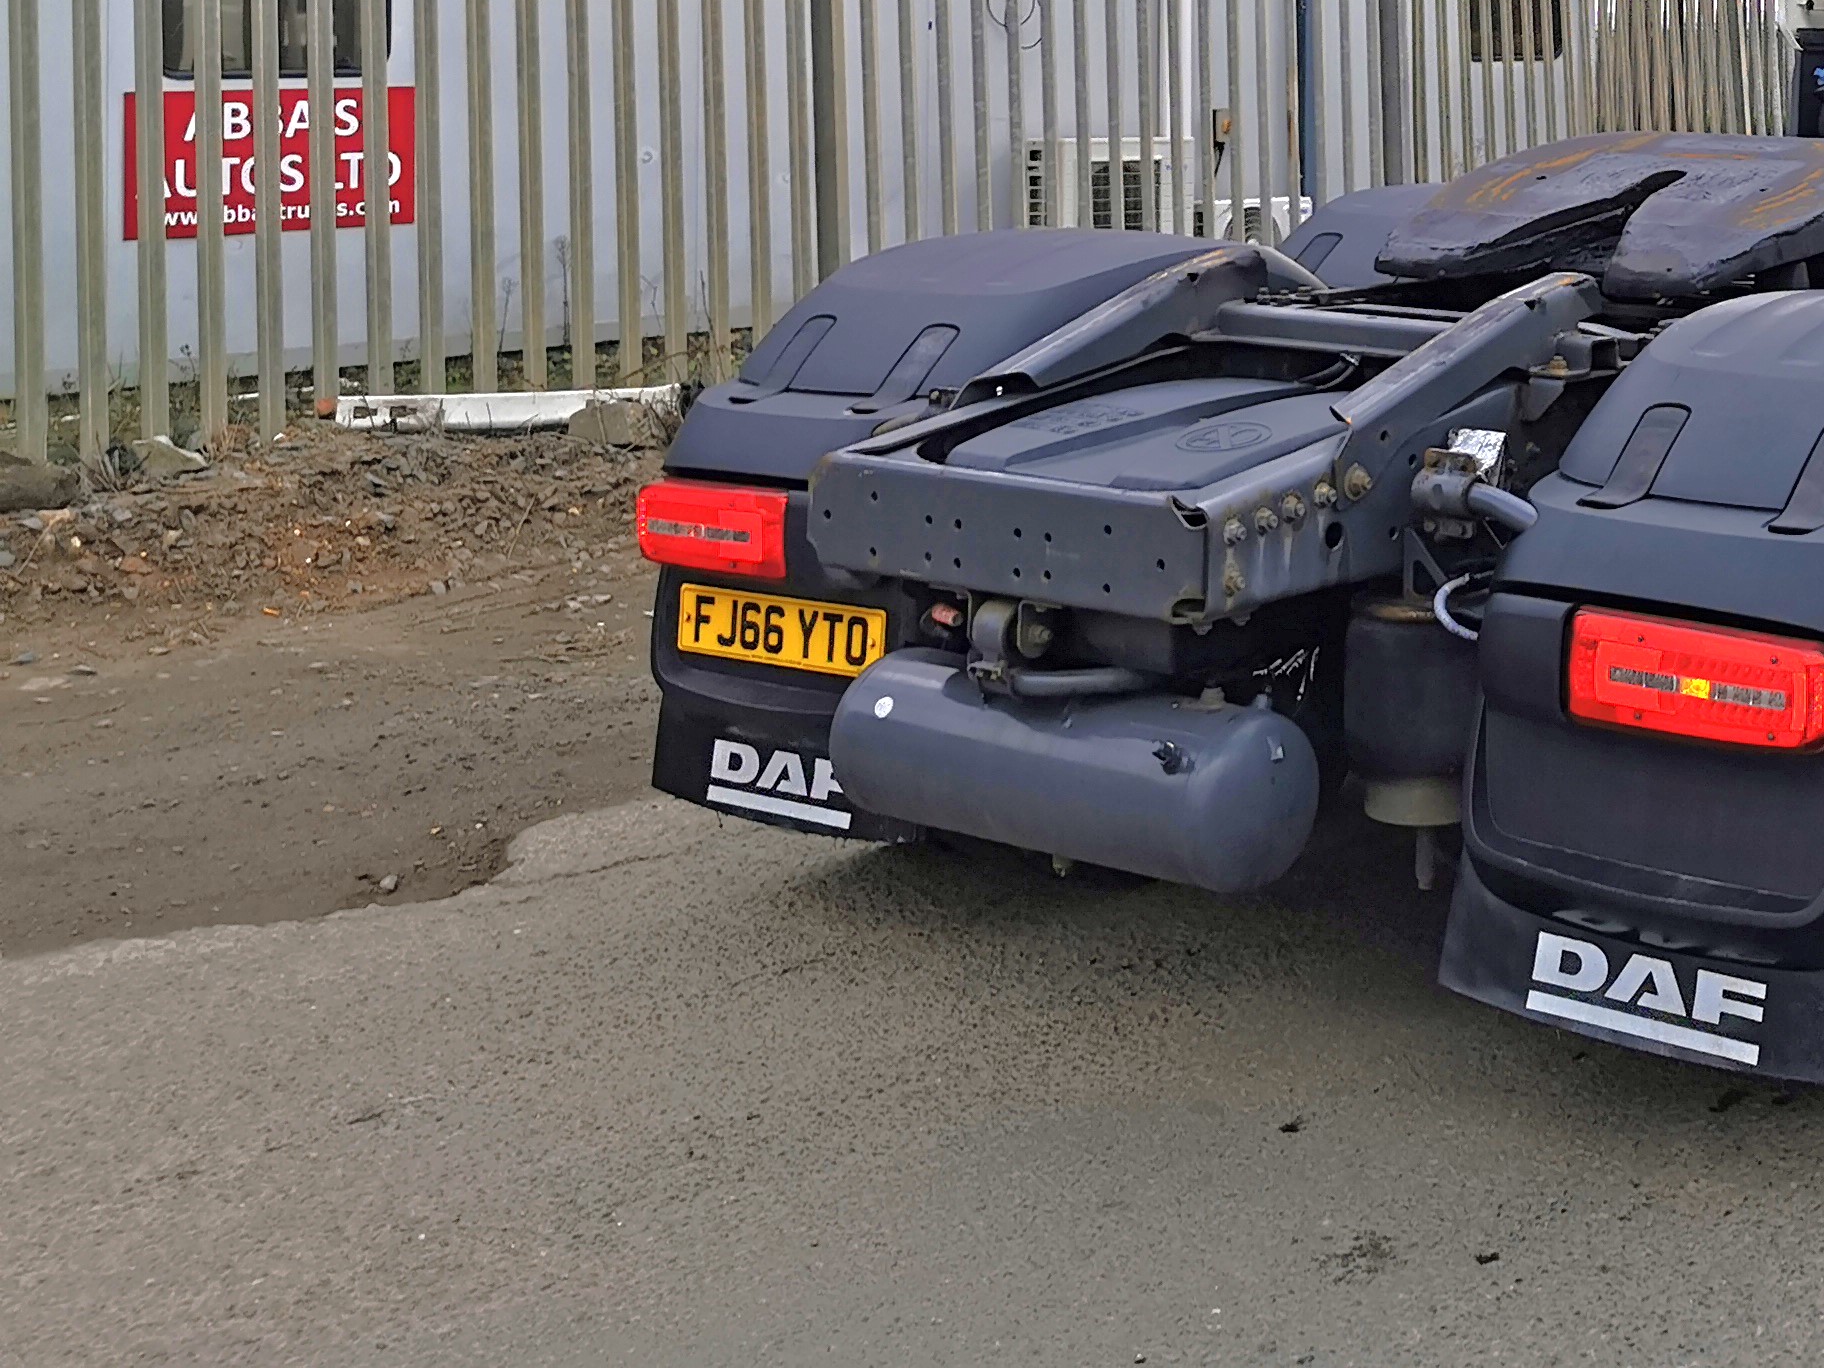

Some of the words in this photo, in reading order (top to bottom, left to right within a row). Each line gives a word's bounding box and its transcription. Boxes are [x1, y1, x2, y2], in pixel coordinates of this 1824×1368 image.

[694, 594, 785, 654] FJ66
[799, 607, 868, 667] YTO
[1532, 931, 1767, 1025] DAF
